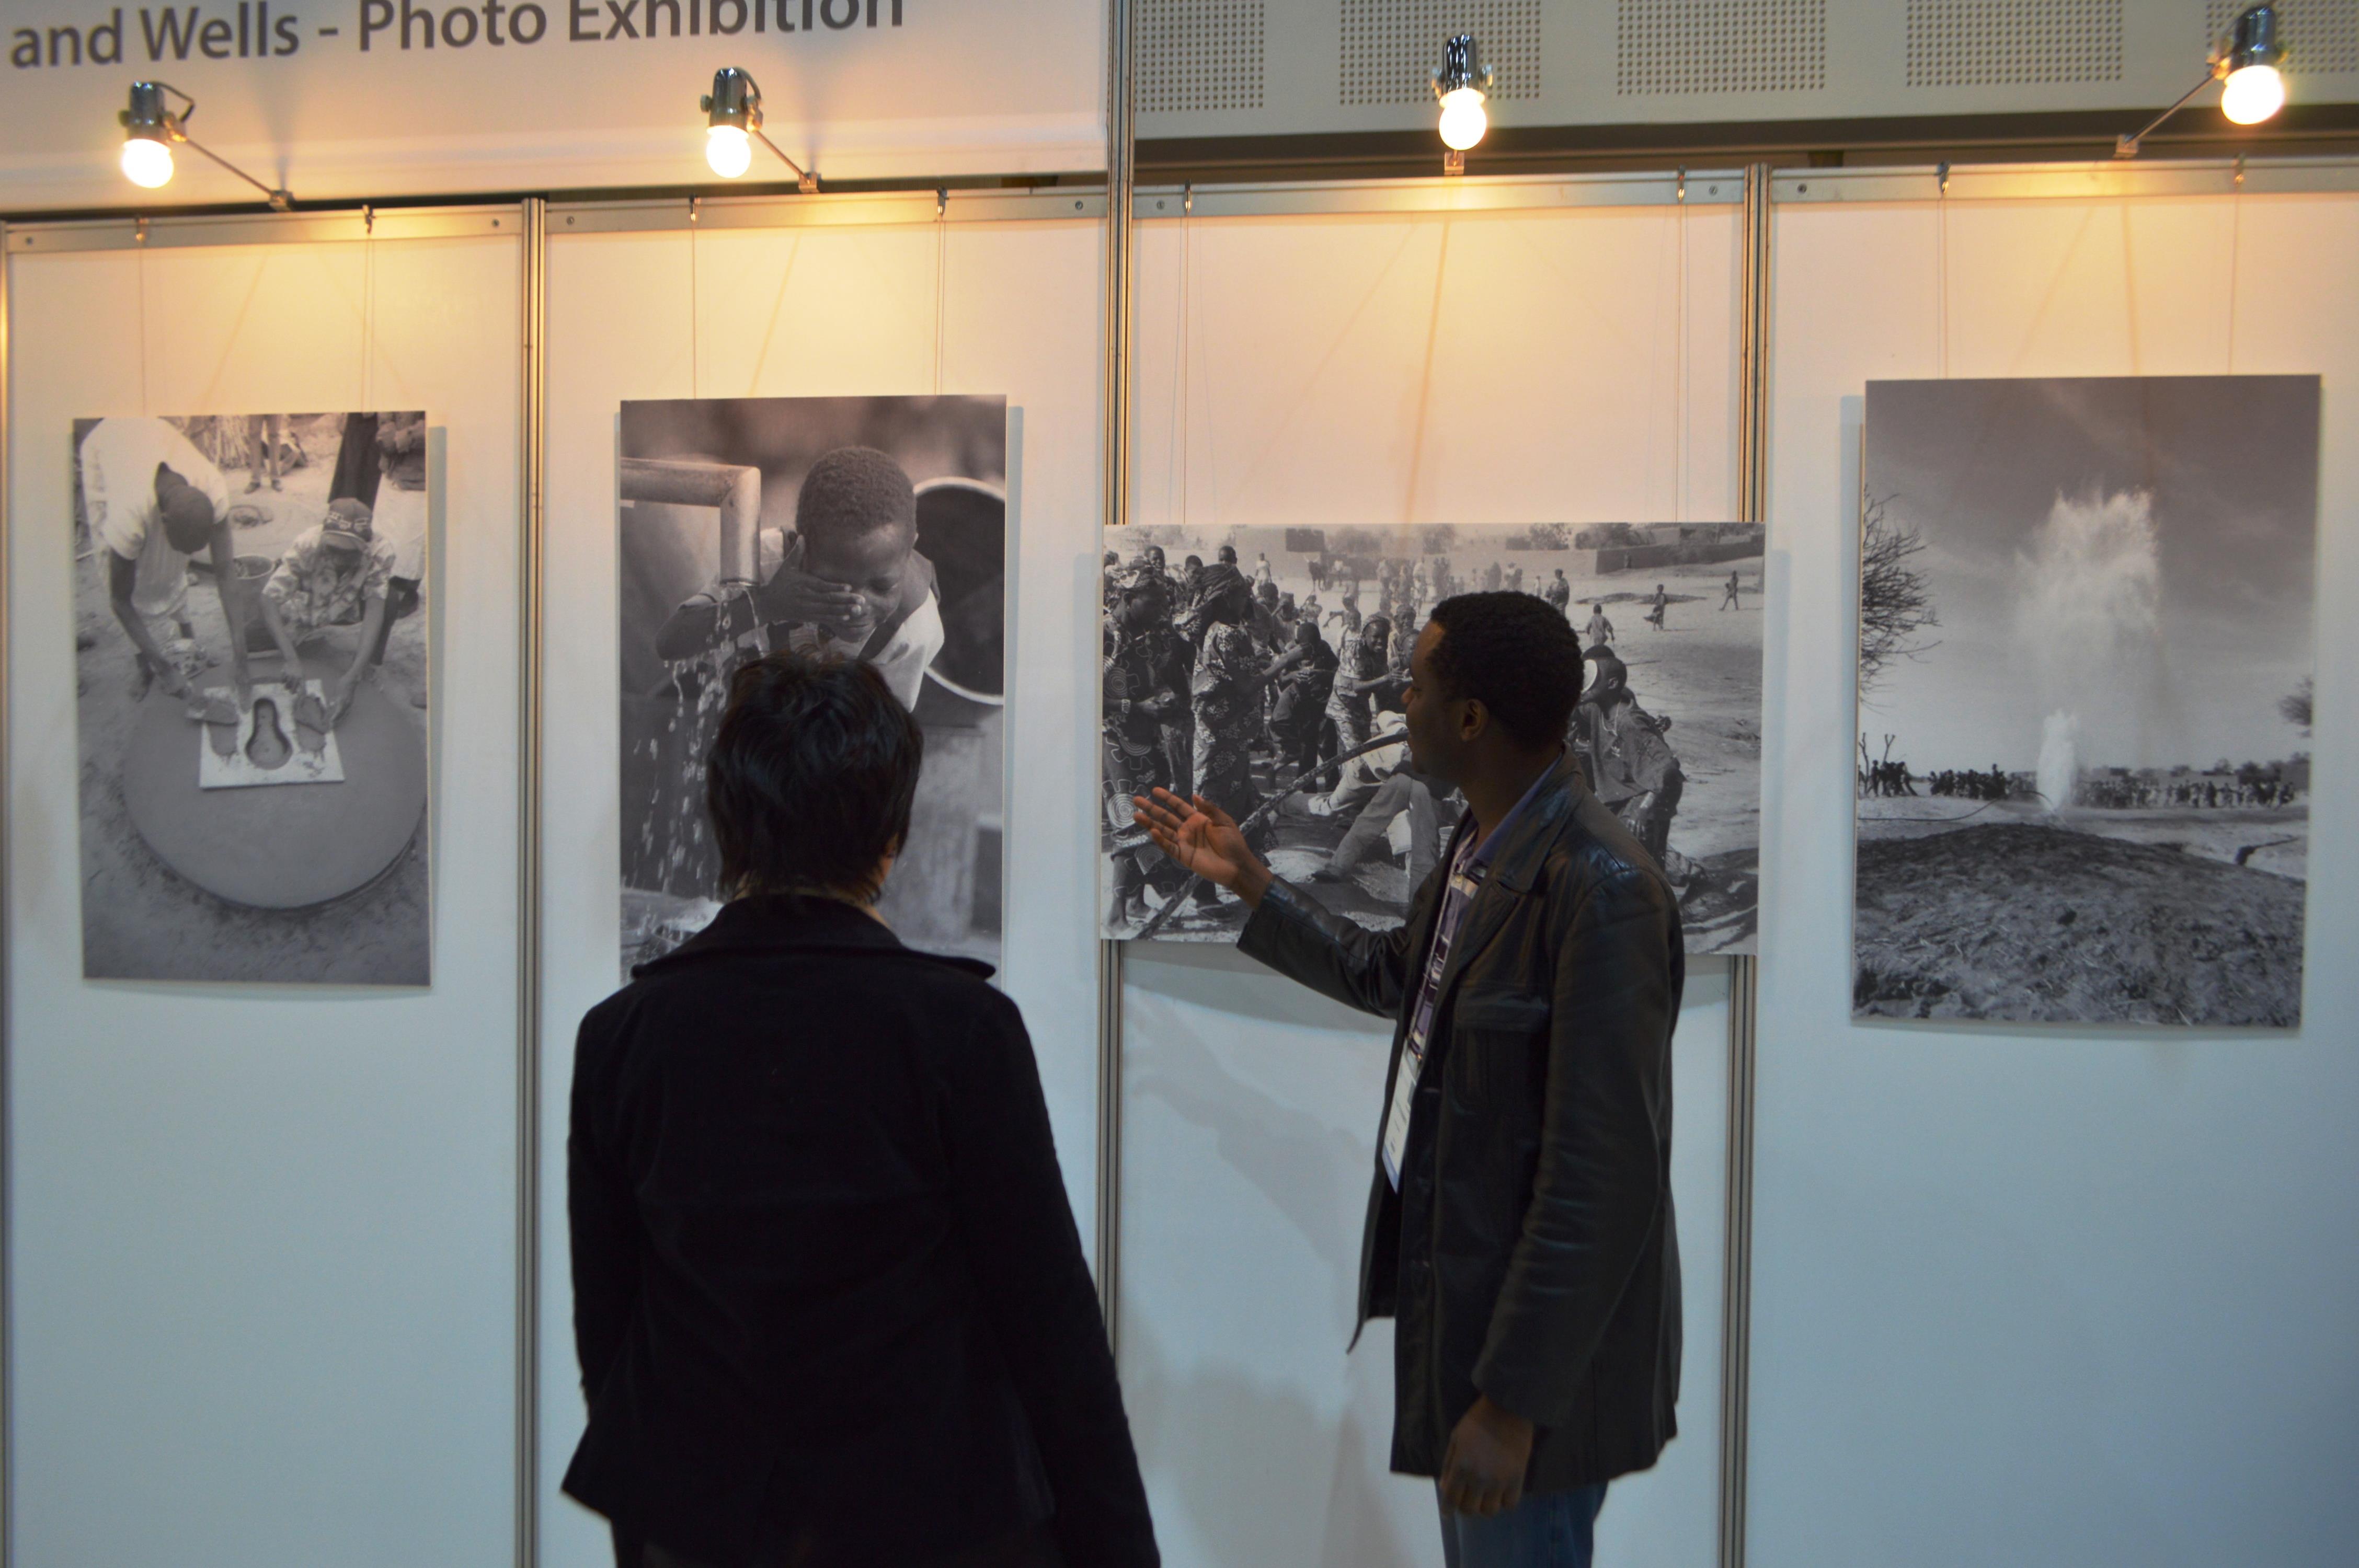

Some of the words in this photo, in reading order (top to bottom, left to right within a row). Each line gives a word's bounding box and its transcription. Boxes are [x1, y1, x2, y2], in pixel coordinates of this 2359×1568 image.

[11, 7, 122, 68] and
[139, 1, 300, 61] Wells
[359, 0, 547, 52] Photo
[568, 0, 903, 42] Exhibition
